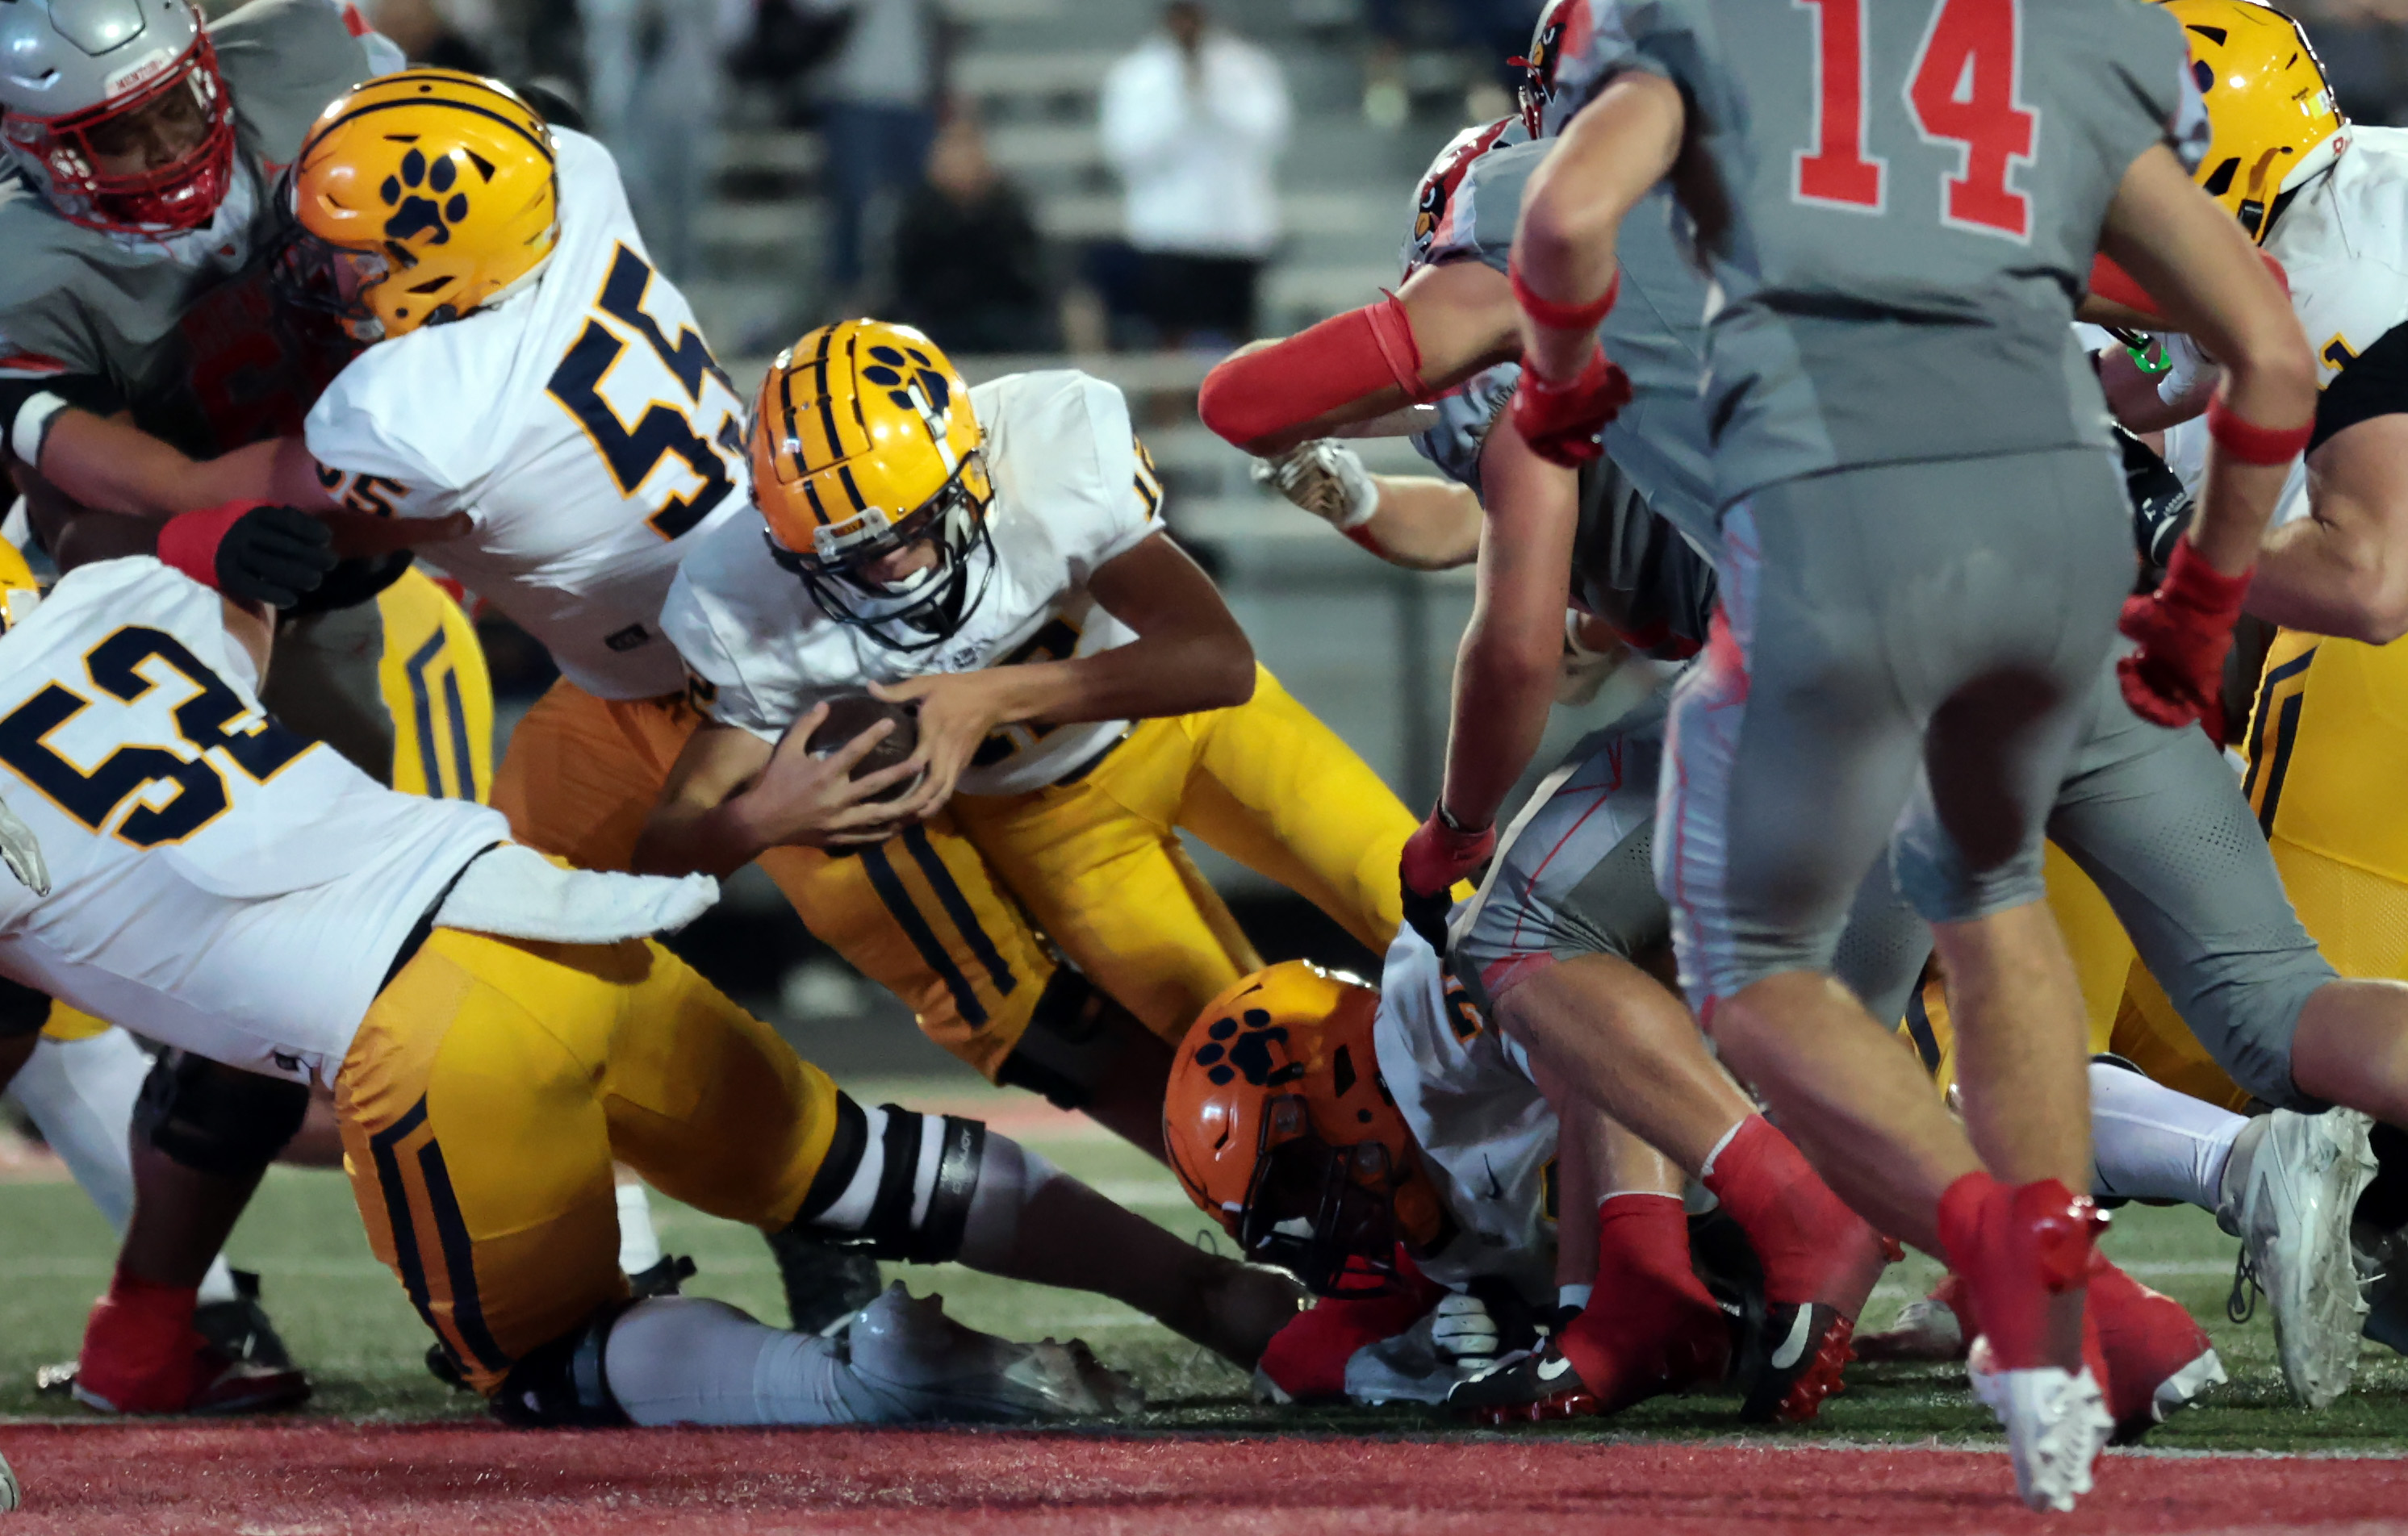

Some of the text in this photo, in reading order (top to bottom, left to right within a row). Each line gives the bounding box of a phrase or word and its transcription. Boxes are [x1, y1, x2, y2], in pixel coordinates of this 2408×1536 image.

[1791, 0, 2041, 246] 14
[544, 239, 749, 542] 55
[0, 624, 325, 852] 52
